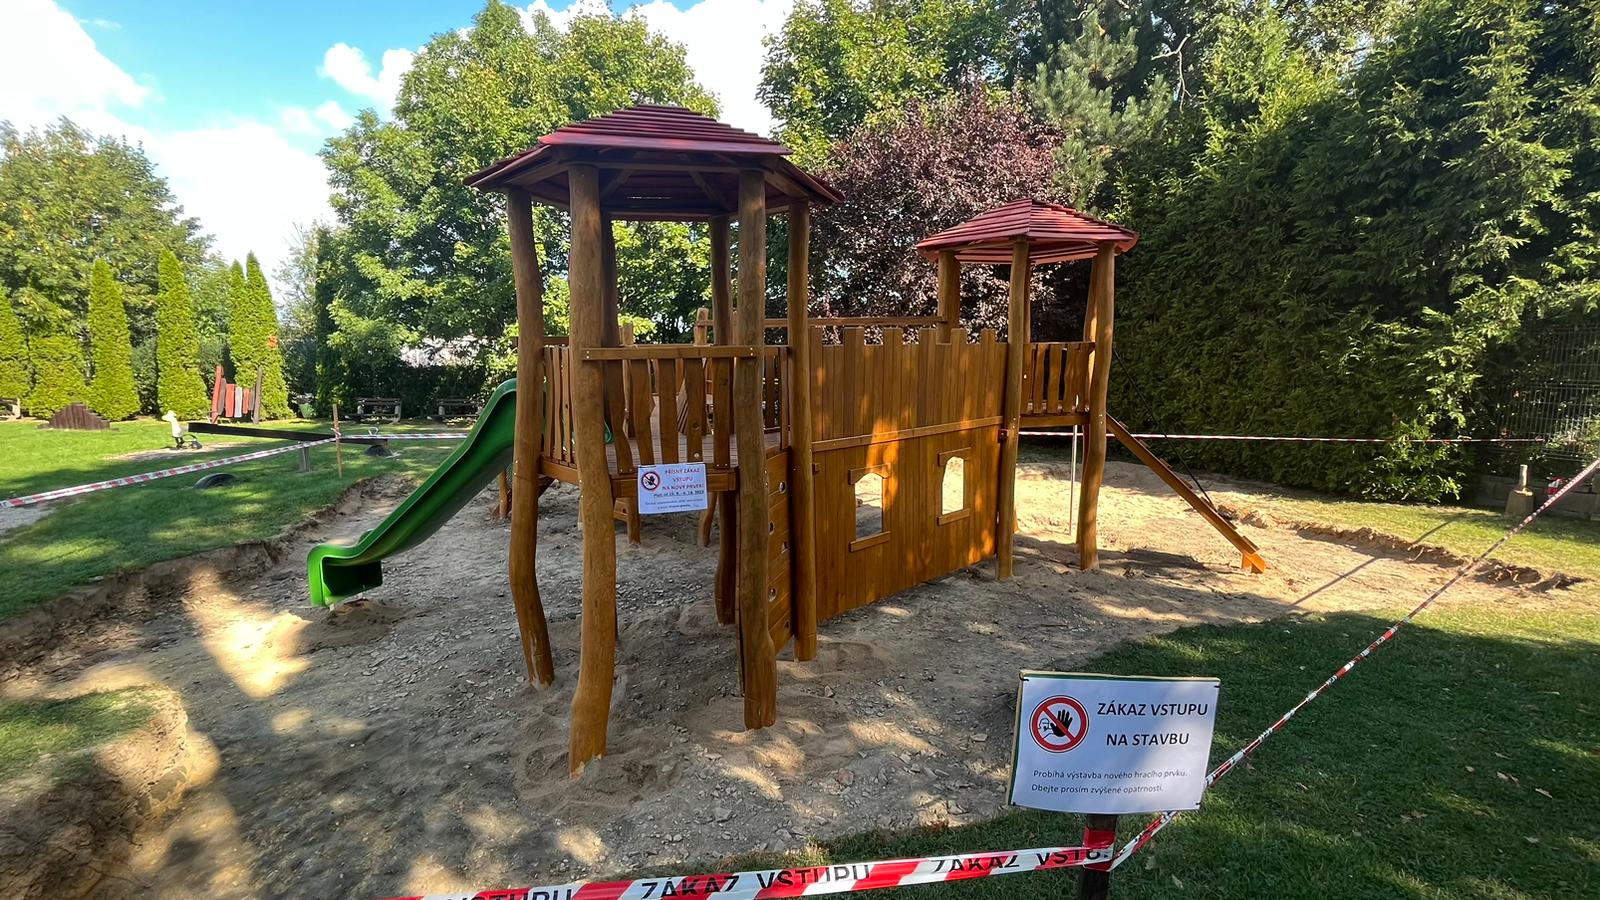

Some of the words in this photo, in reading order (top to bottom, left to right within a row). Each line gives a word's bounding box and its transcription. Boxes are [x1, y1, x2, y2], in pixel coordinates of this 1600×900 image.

[1097, 700, 1147, 716] ZÁKAZ
[1151, 702, 1209, 716] VSTUPU
[1106, 733, 1128, 746] NA
[1131, 732, 1190, 746] STAVBU
[1033, 769, 1065, 779] Probíhá
[1067, 770, 1102, 780] výstavba
[1103, 770, 1133, 779] nového
[1134, 770, 1163, 779] hracího
[1163, 769, 1188, 780] prvku.
[1031, 784, 1059, 794] Dbejte
[1060, 784, 1089, 795] prosím
[1090, 785, 1122, 796] zvýšené
